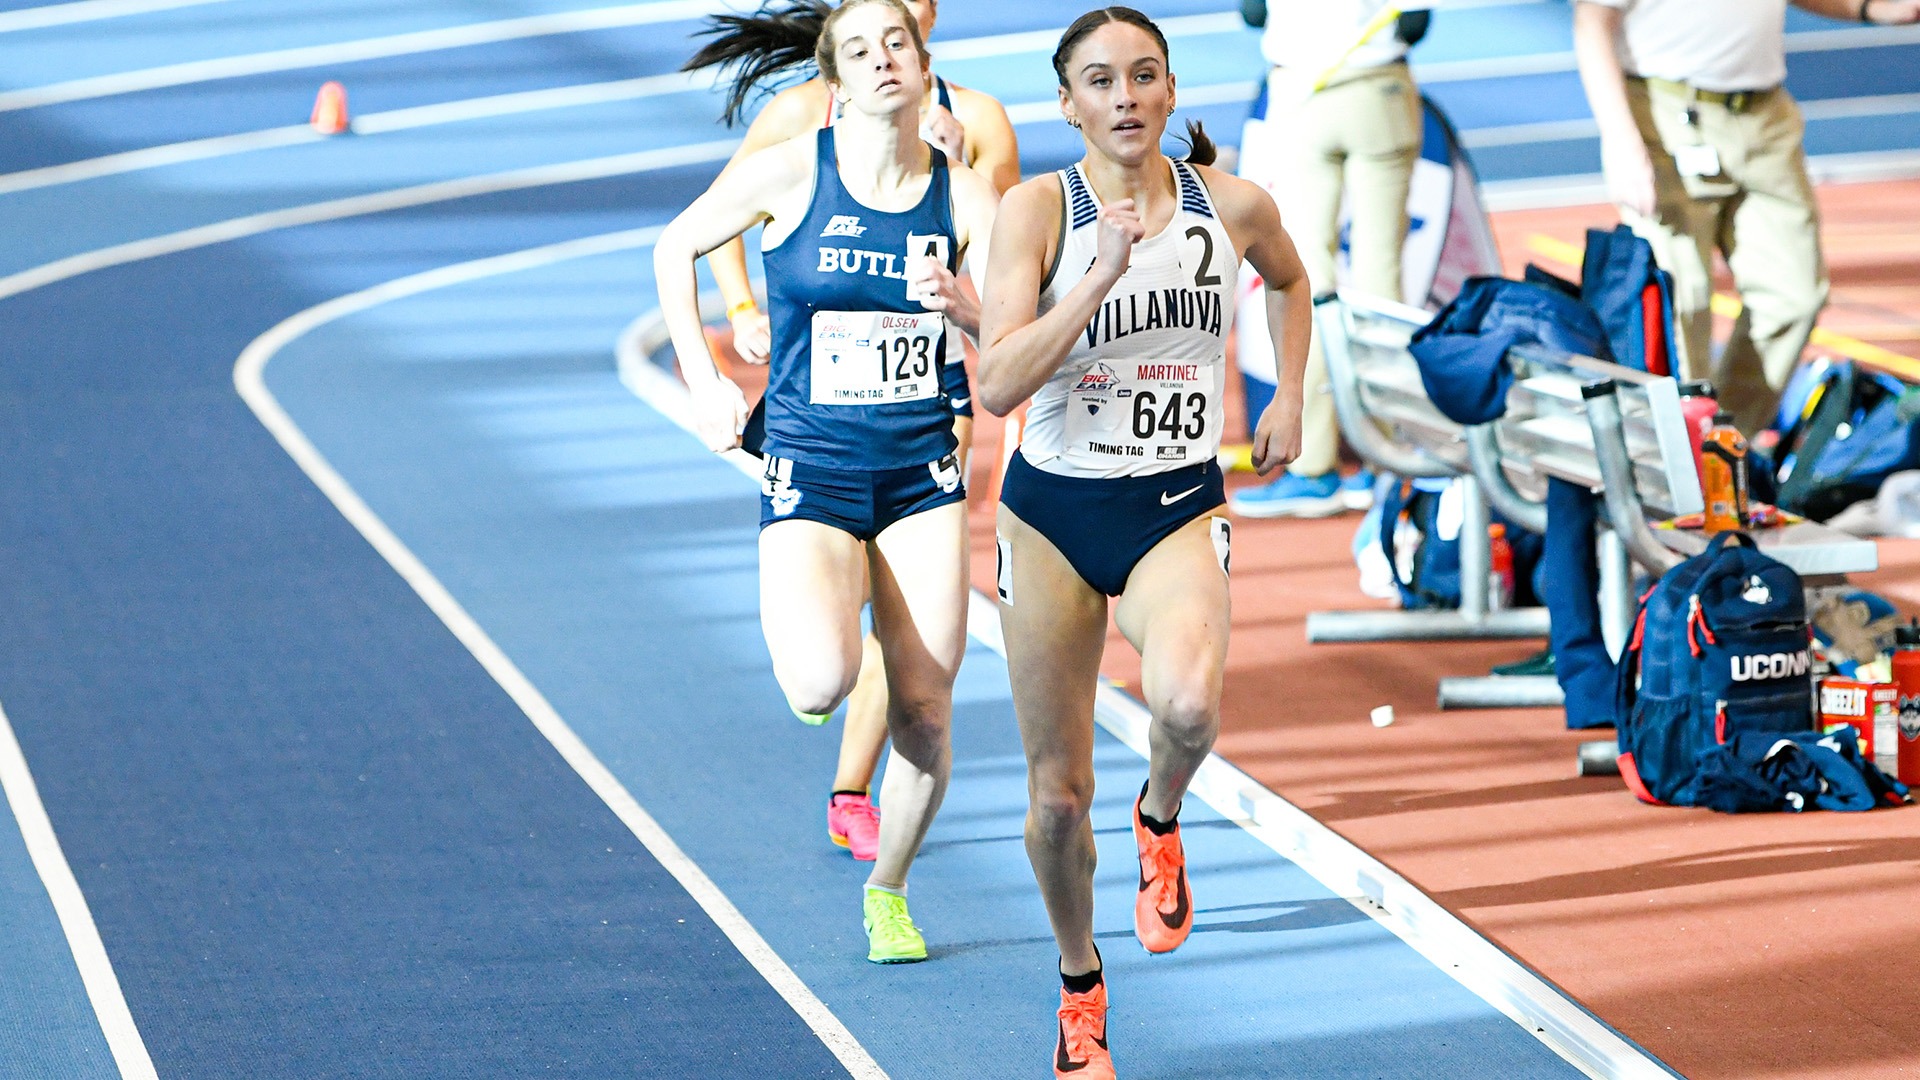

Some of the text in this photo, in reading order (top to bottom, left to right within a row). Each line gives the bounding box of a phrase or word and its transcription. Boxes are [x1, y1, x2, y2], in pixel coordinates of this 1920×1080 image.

[1185, 226, 1221, 287] 2
[882, 316, 919, 329] OLSEN
[1086, 288, 1222, 349] VILLANOVA
[876, 335, 930, 382] 123
[1081, 374, 1109, 383] BIG
[1137, 364, 1198, 381] MARTINEZ
[834, 389, 866, 399] TIMING
[868, 389, 884, 399] TAG
[1076, 382, 1115, 390] EAST
[1132, 390, 1207, 440] 643
[1088, 441, 1144, 457] TIMING TAG
